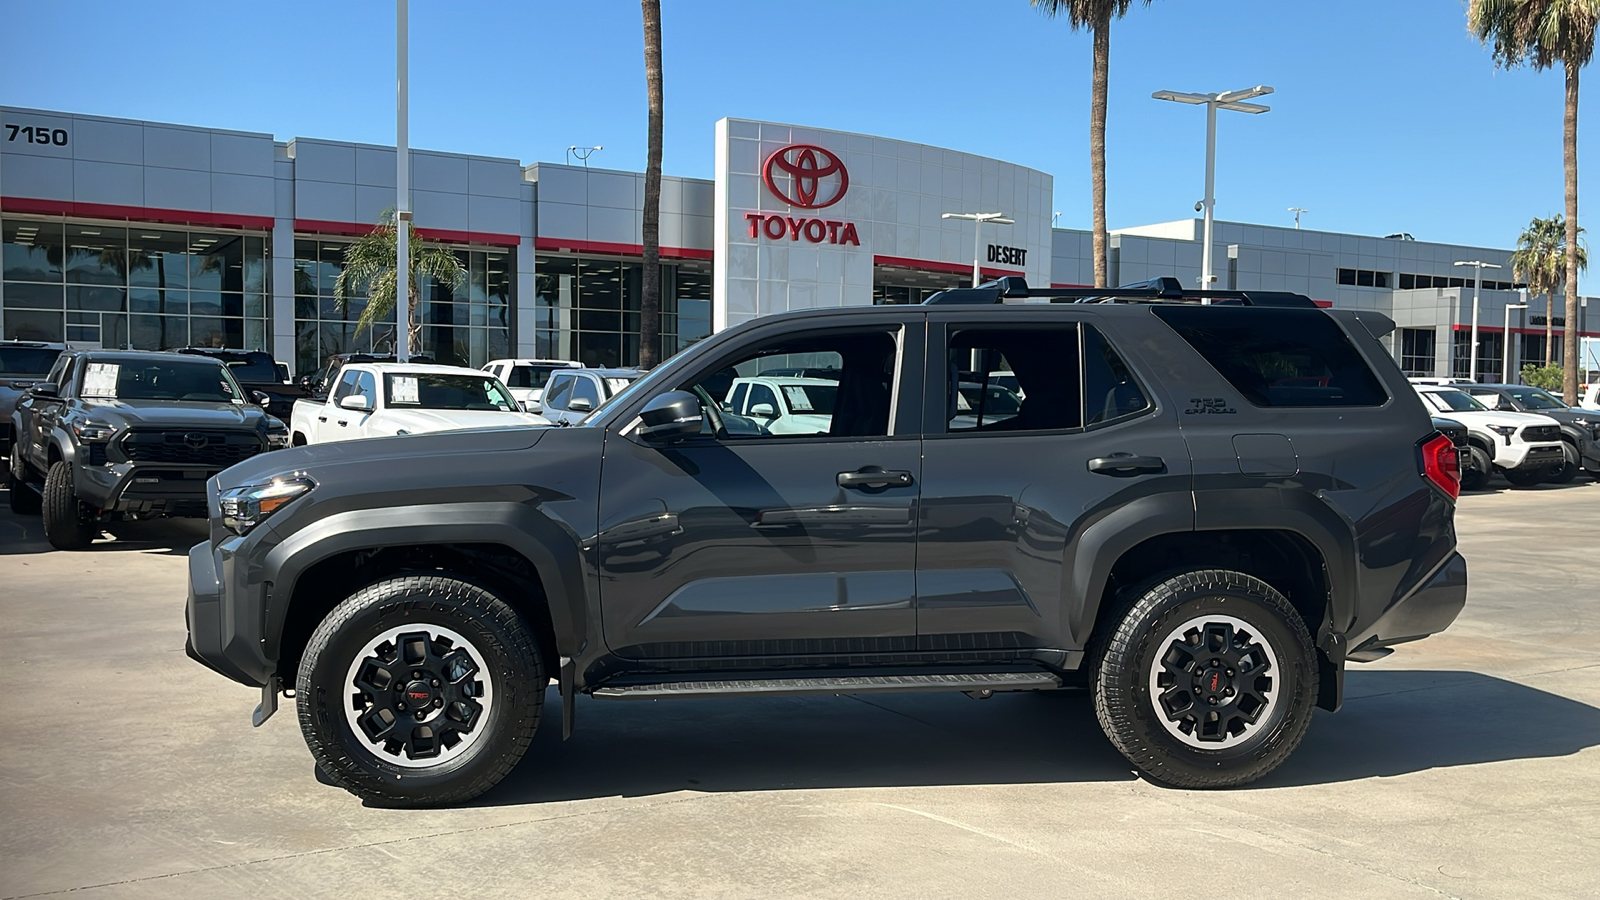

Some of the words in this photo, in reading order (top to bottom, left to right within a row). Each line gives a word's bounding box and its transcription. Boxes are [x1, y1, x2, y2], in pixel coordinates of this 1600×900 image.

[5, 124, 68, 146] 7150
[744, 213, 861, 246] TOYOTA
[987, 244, 1028, 266] DESERT
[1190, 398, 1226, 409] TRD
[378, 600, 508, 659] WILDPEAK
[1211, 672, 1219, 692] TRD
